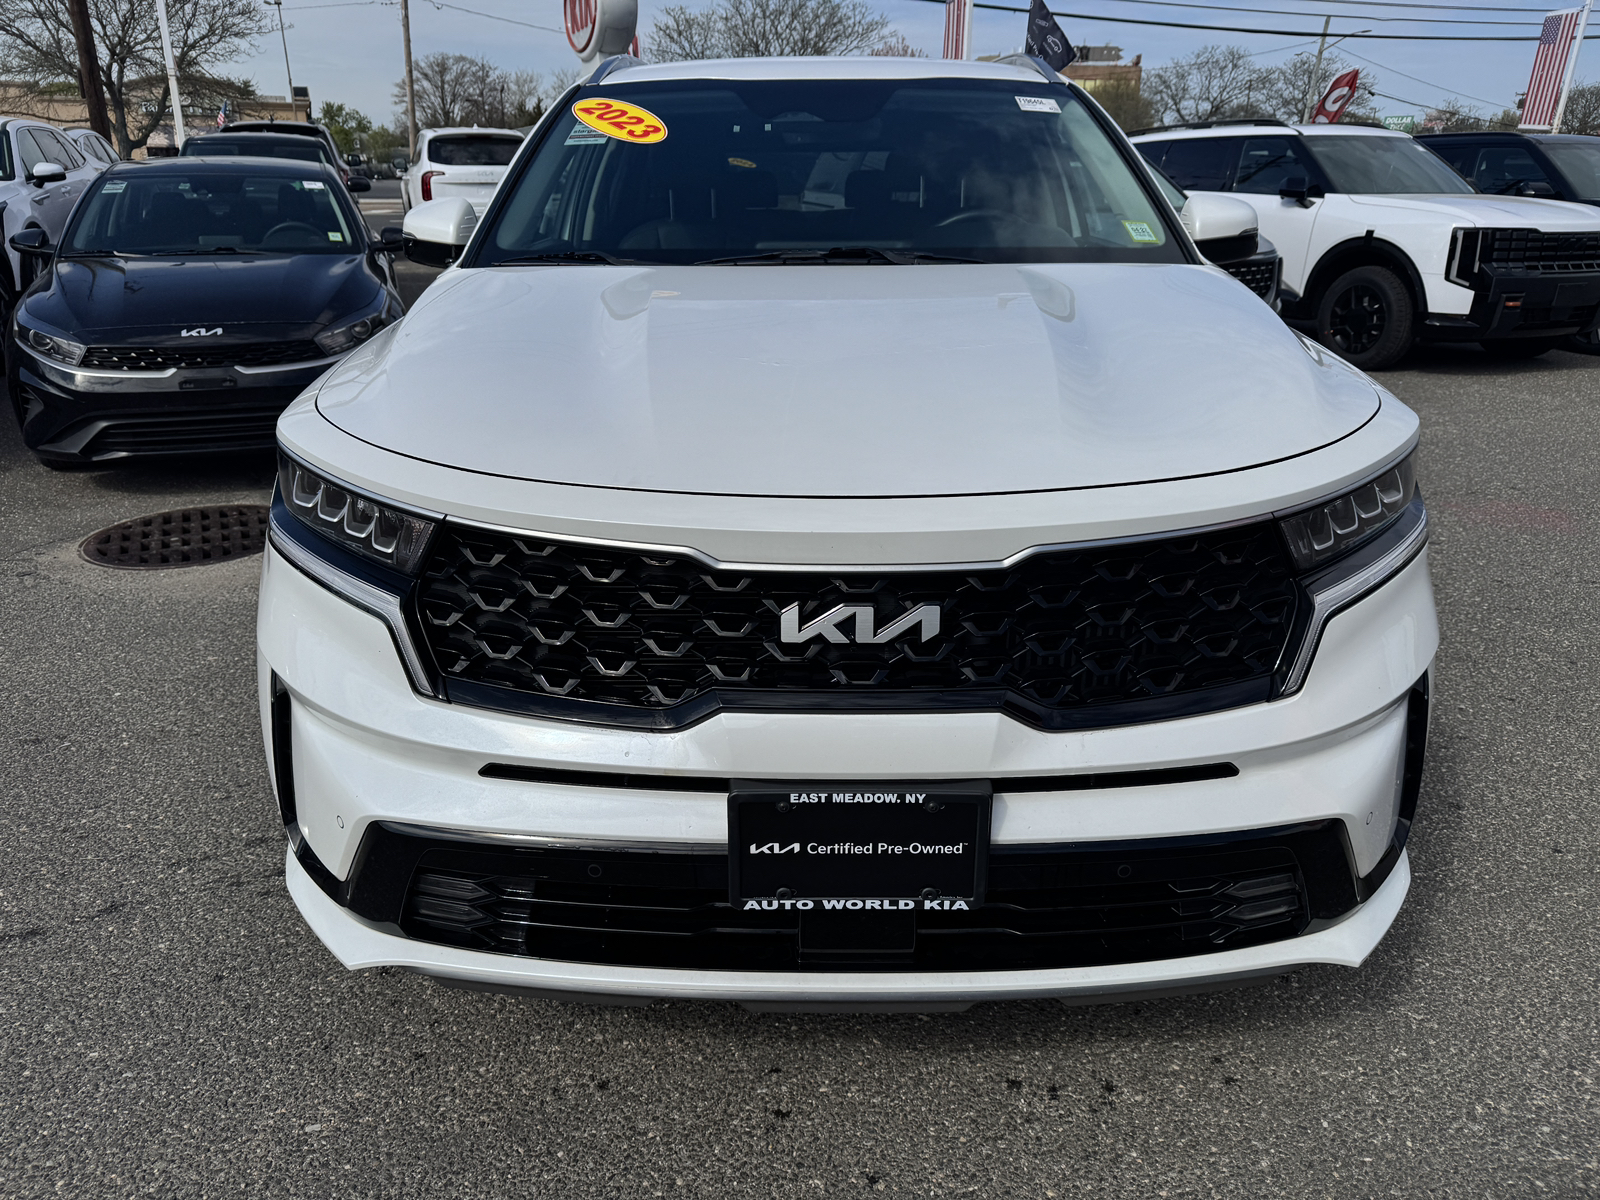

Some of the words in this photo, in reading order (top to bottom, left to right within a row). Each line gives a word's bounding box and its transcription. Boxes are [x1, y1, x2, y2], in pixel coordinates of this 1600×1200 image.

[577, 102, 662, 139] 2023
[1385, 116, 1412, 124] DOLLAR
[180, 327, 223, 337] KIA
[780, 600, 941, 643] KIA
[790, 793, 828, 804] EAST
[905, 793, 927, 804] NY
[749, 842, 801, 855] KIA
[807, 842, 873, 855] Certified
[743, 899, 813, 911] AUTO
[822, 899, 915, 911] WORLD
[923, 899, 970, 911] KIA
